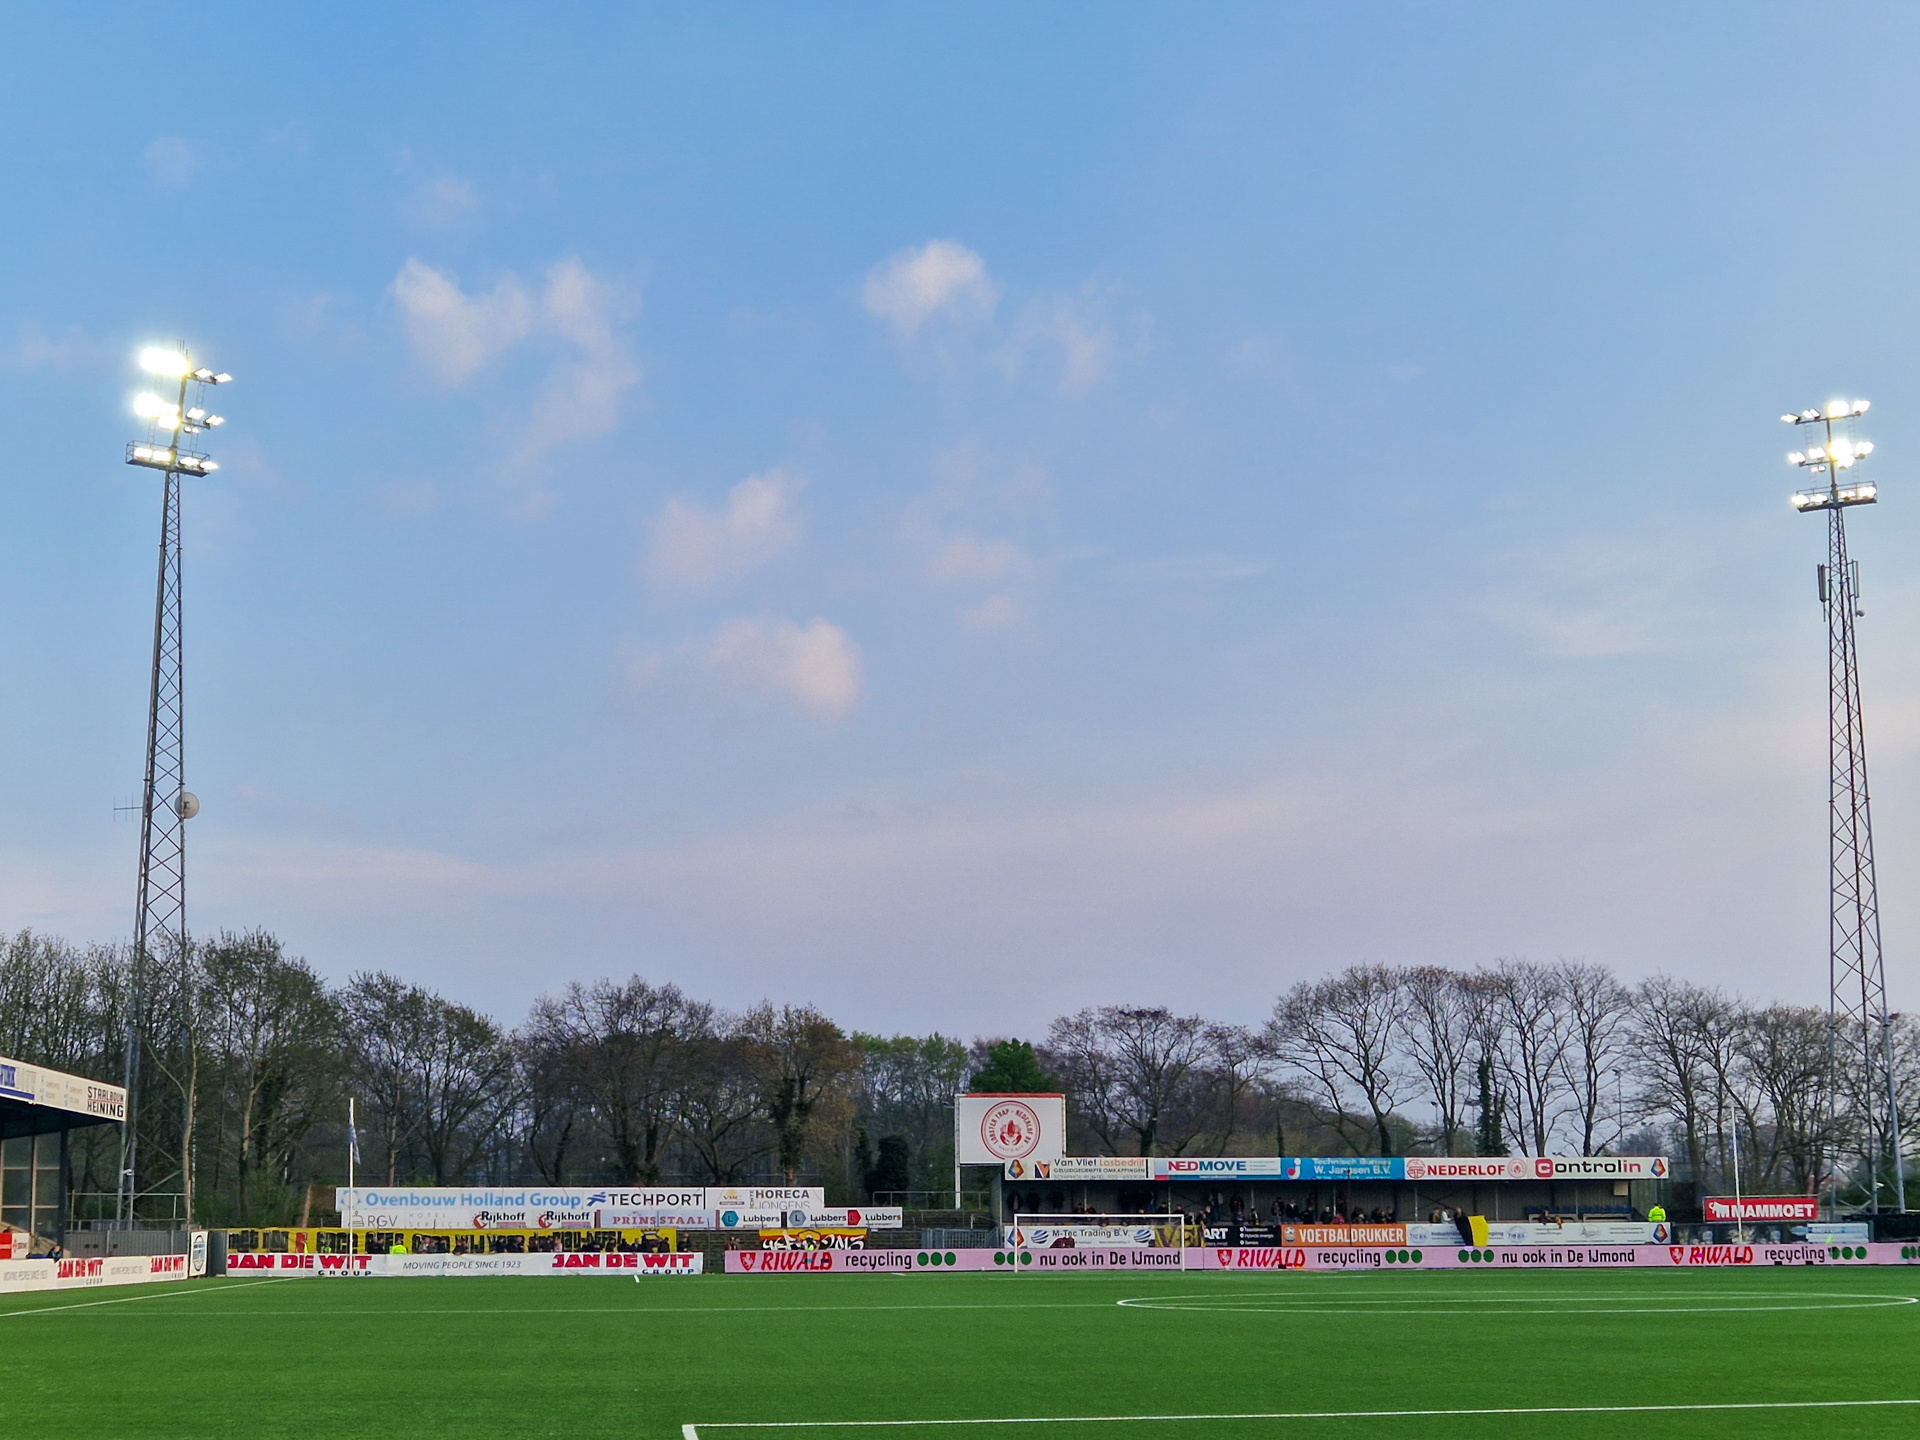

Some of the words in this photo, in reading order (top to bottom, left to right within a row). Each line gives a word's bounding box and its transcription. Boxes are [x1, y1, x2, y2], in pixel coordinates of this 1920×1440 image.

[87, 1085, 124, 1102] STAALBOUW
[86, 1102, 124, 1118] HEINING
[995, 1108, 1010, 1119] TRAP
[1015, 1109, 1033, 1135] NEDERLOF
[1054, 1158, 1073, 1167] Van
[1076, 1158, 1097, 1167] Vliet
[1099, 1158, 1145, 1168] Lasbedrijf
[1168, 1160, 1247, 1171] NEDMOVE
[1314, 1165, 1326, 1174] W.
[1372, 1165, 1391, 1174] B.V.
[1427, 1164, 1505, 1175] NEDERLOF
[365, 1192, 456, 1206] Ovenbouw
[461, 1192, 525, 1206] Holland
[530, 1193, 581, 1209] Group
[608, 1193, 702, 1206] TECHPORT
[755, 1189, 810, 1199] HORECA
[481, 1210, 526, 1223] Rijkhoff
[545, 1210, 590, 1222] Rijkhoff
[743, 1214, 780, 1222] Lubbers
[865, 1213, 901, 1221] Lubbers
[1731, 1204, 1815, 1218] MAMMOET
[368, 1215, 398, 1227] RGV
[612, 1216, 657, 1225] PRINS
[659, 1216, 705, 1225] STAAL
[1052, 1229, 1076, 1238] M-Tec
[1079, 1229, 1111, 1239] Trading
[1114, 1229, 1130, 1238] B.V.
[1299, 1227, 1404, 1243] VOETBALDRUKKER
[227, 1254, 275, 1269] JAN
[281, 1254, 314, 1269] DE
[318, 1254, 372, 1269] WIT
[552, 1254, 601, 1268] JAN
[605, 1254, 638, 1268] DE
[641, 1254, 695, 1268] WIT
[760, 1251, 833, 1271] RIWALD
[845, 1252, 912, 1270] recycling
[1039, 1255, 1059, 1265] nu
[1062, 1251, 1087, 1265] ook
[1092, 1251, 1104, 1265] in
[1109, 1251, 1126, 1265] De
[1132, 1251, 1181, 1265] IJmond
[1237, 1249, 1306, 1267] RIWALD
[1317, 1249, 1381, 1267] recycling
[1501, 1252, 1518, 1263] nu
[1522, 1249, 1546, 1263] ook
[1550, 1249, 1562, 1262] in
[1567, 1249, 1584, 1262] De
[1588, 1249, 1635, 1262] IJmond
[1689, 1246, 1754, 1265] RIWALD
[1764, 1247, 1826, 1263] recycling
[57, 1260, 73, 1279] JAN
[75, 1260, 86, 1278] DE
[87, 1259, 104, 1277] WIT
[150, 1257, 163, 1273] JAN
[164, 1257, 172, 1272] DE
[173, 1256, 185, 1271] WIT
[402, 1261, 439, 1270] MOVING
[441, 1261, 473, 1270] PEOPLE
[475, 1260, 500, 1270] SINCE
[501, 1260, 522, 1269] 1923
